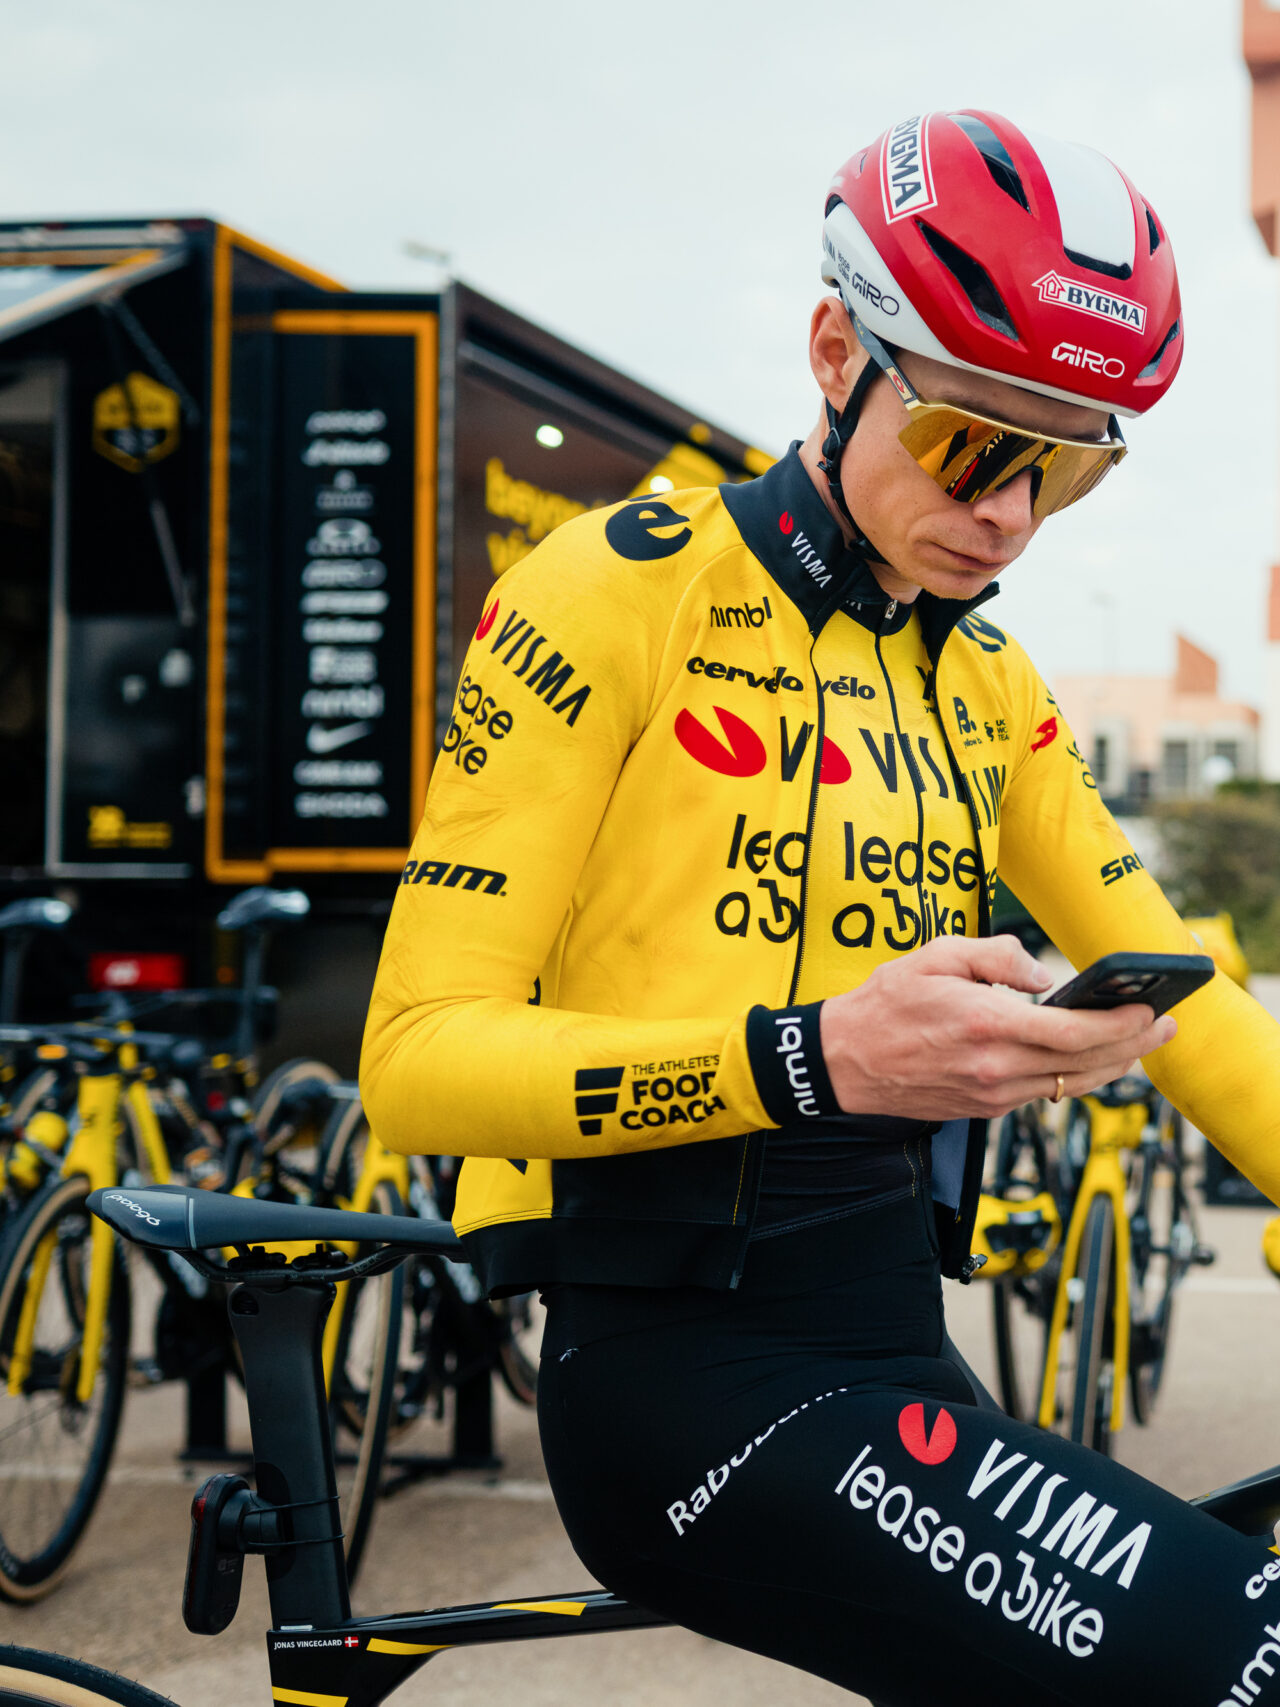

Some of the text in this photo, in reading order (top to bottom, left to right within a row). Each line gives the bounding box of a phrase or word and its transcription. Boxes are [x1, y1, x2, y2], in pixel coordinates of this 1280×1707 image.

[890, 116, 922, 208] BYGMA
[1067, 286, 1140, 326] BYGMA
[791, 531, 833, 589] VISMA
[710, 596, 773, 628] nimbl
[490, 610, 592, 728] VISMA
[844, 821, 979, 892] lease
[632, 1054, 720, 1076] THE ATHLETE'S
[775, 1016, 820, 1117] nimbl
[620, 1095, 726, 1131] COACH
[105, 1194, 161, 1226] prologo
[834, 1444, 965, 1573] lease
[967, 1438, 1152, 1590] VISMA
[273, 1638, 343, 1650] JONAS VINGEGAARD
